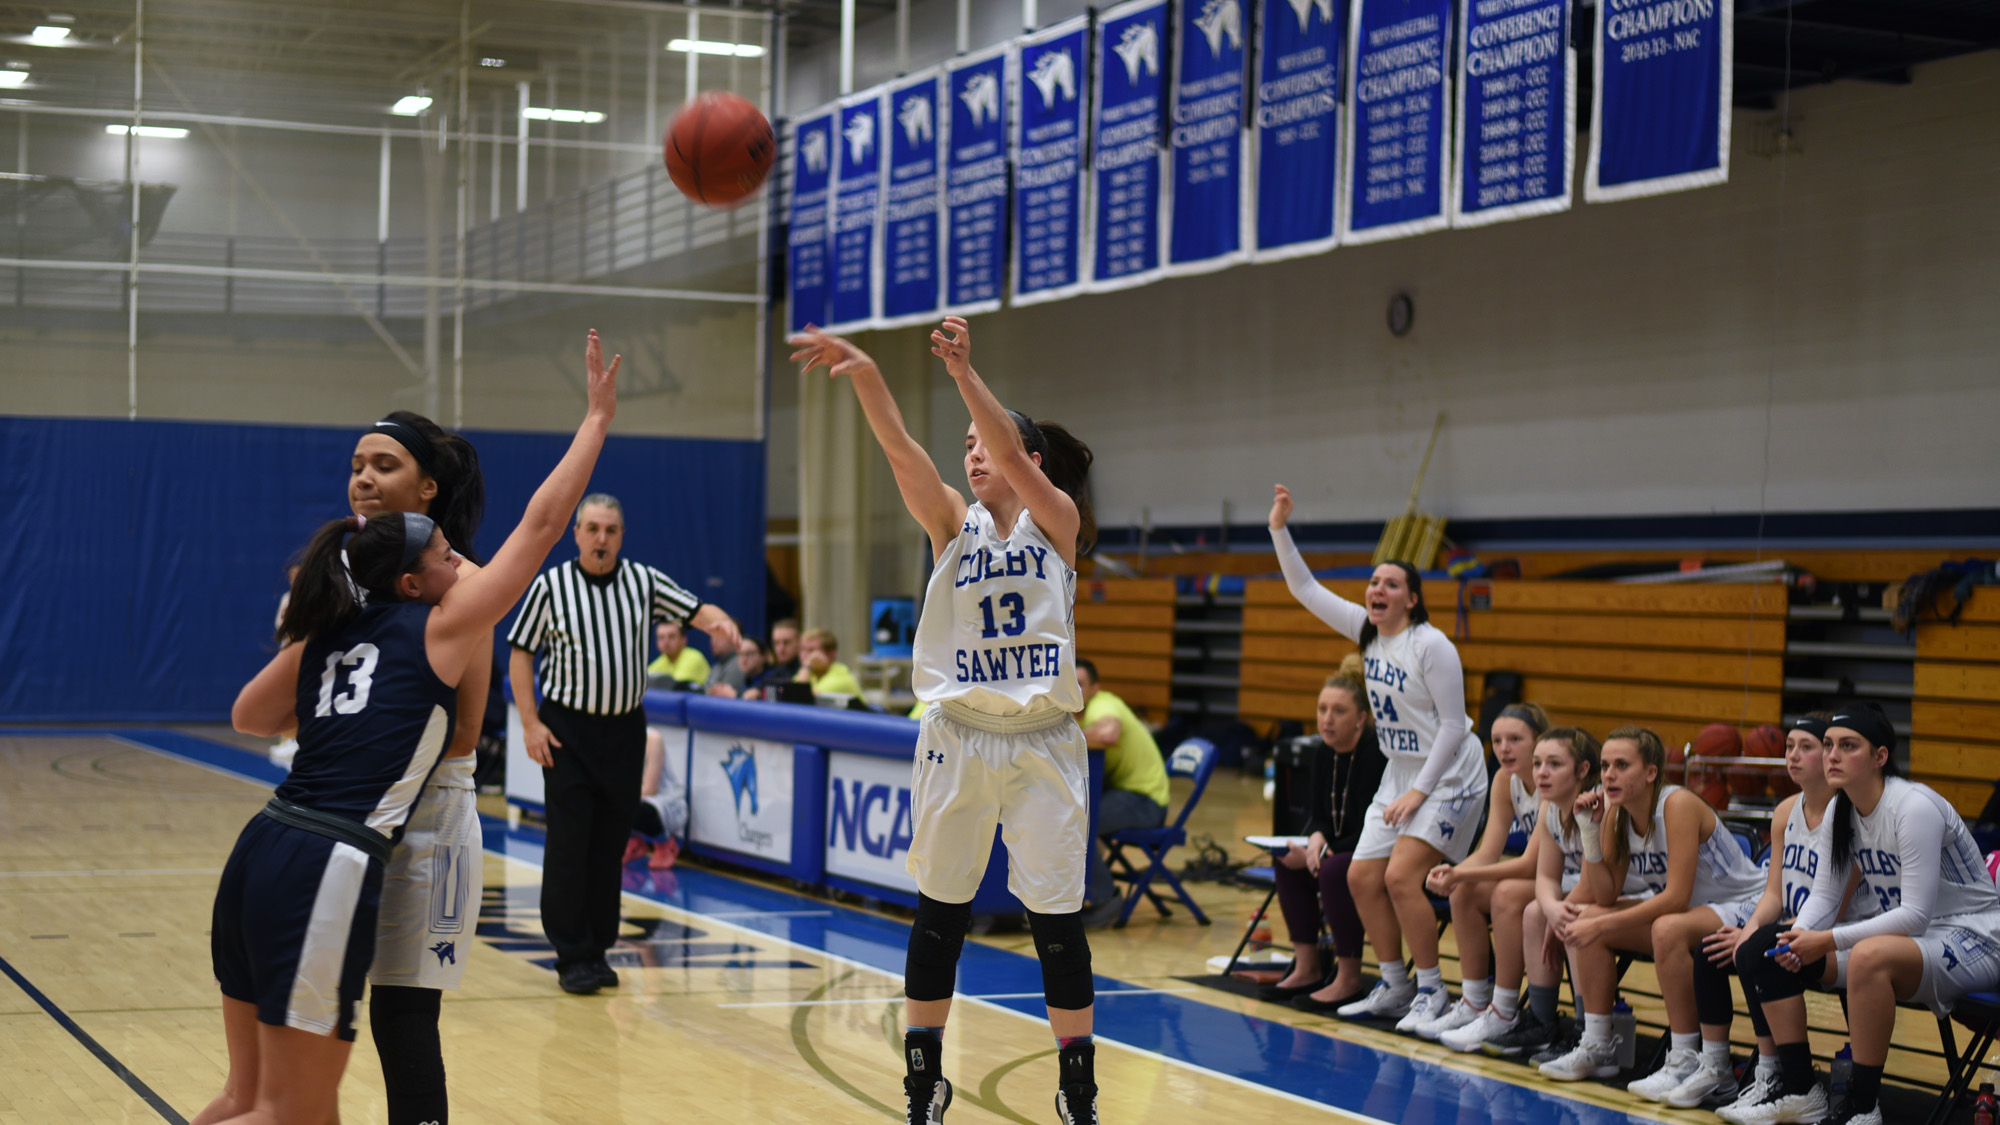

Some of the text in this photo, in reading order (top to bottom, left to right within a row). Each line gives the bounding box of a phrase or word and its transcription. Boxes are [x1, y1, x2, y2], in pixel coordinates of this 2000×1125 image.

[1361, 34, 1441, 76] CONFERENC
[1467, 31, 1560, 77] CHAMPION
[1259, 64, 1335, 103] CONFERENC
[1173, 91, 1240, 124] CONFERENC
[1171, 114, 1238, 148] CHAMPION
[956, 545, 1048, 588] COLBY
[979, 592, 1026, 638] 13
[315, 643, 380, 717] 13
[956, 643, 1060, 683] SAWYER
[1371, 690, 1399, 722] 24
[1377, 725, 1420, 752] WYER
[830, 777, 912, 860] NCA
[1782, 844, 1819, 879] OLB
[1786, 882, 1811, 918] 10
